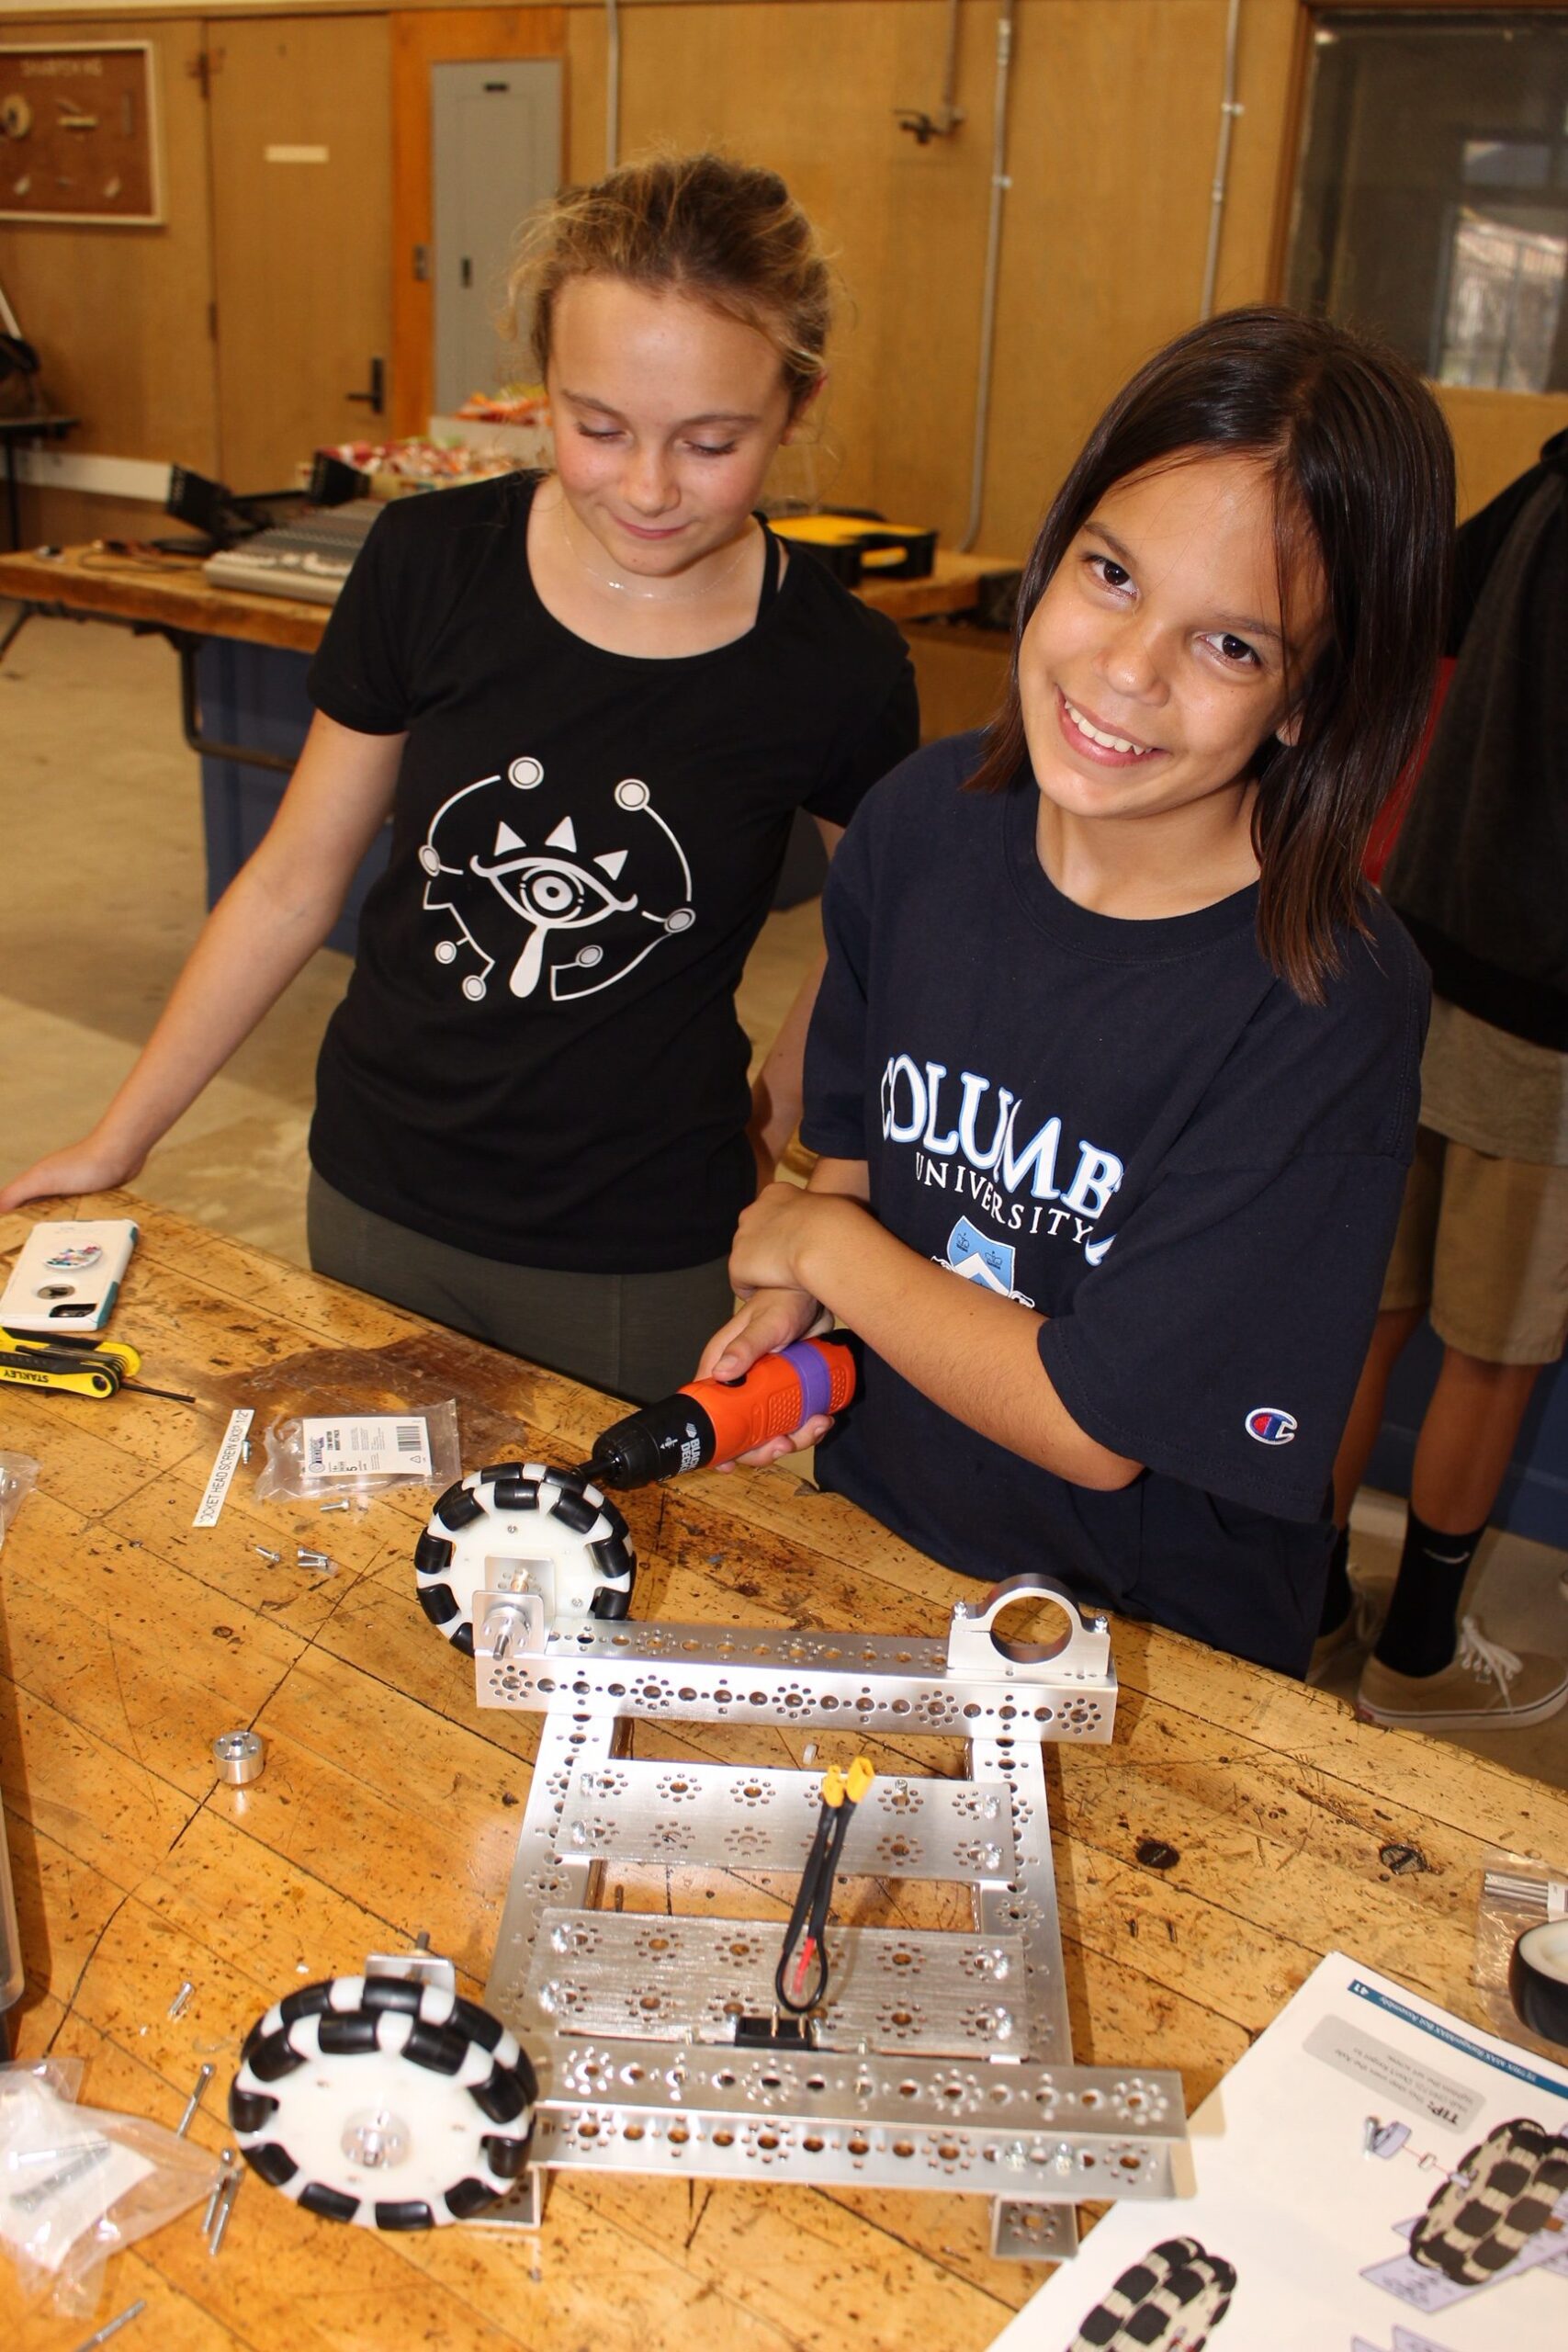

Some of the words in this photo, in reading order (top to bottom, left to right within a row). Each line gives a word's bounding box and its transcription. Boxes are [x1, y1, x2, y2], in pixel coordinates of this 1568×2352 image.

[881, 1054, 1123, 1265] COLUMB
[916, 1152, 1093, 1244] UNIVERSITY
[4, 1369, 49, 1383] STANLEY
[219, 1443, 236, 1471] SCREW
[212, 1472, 228, 1493] HEAD
[1427, 2101, 1459, 2124] TIP:
